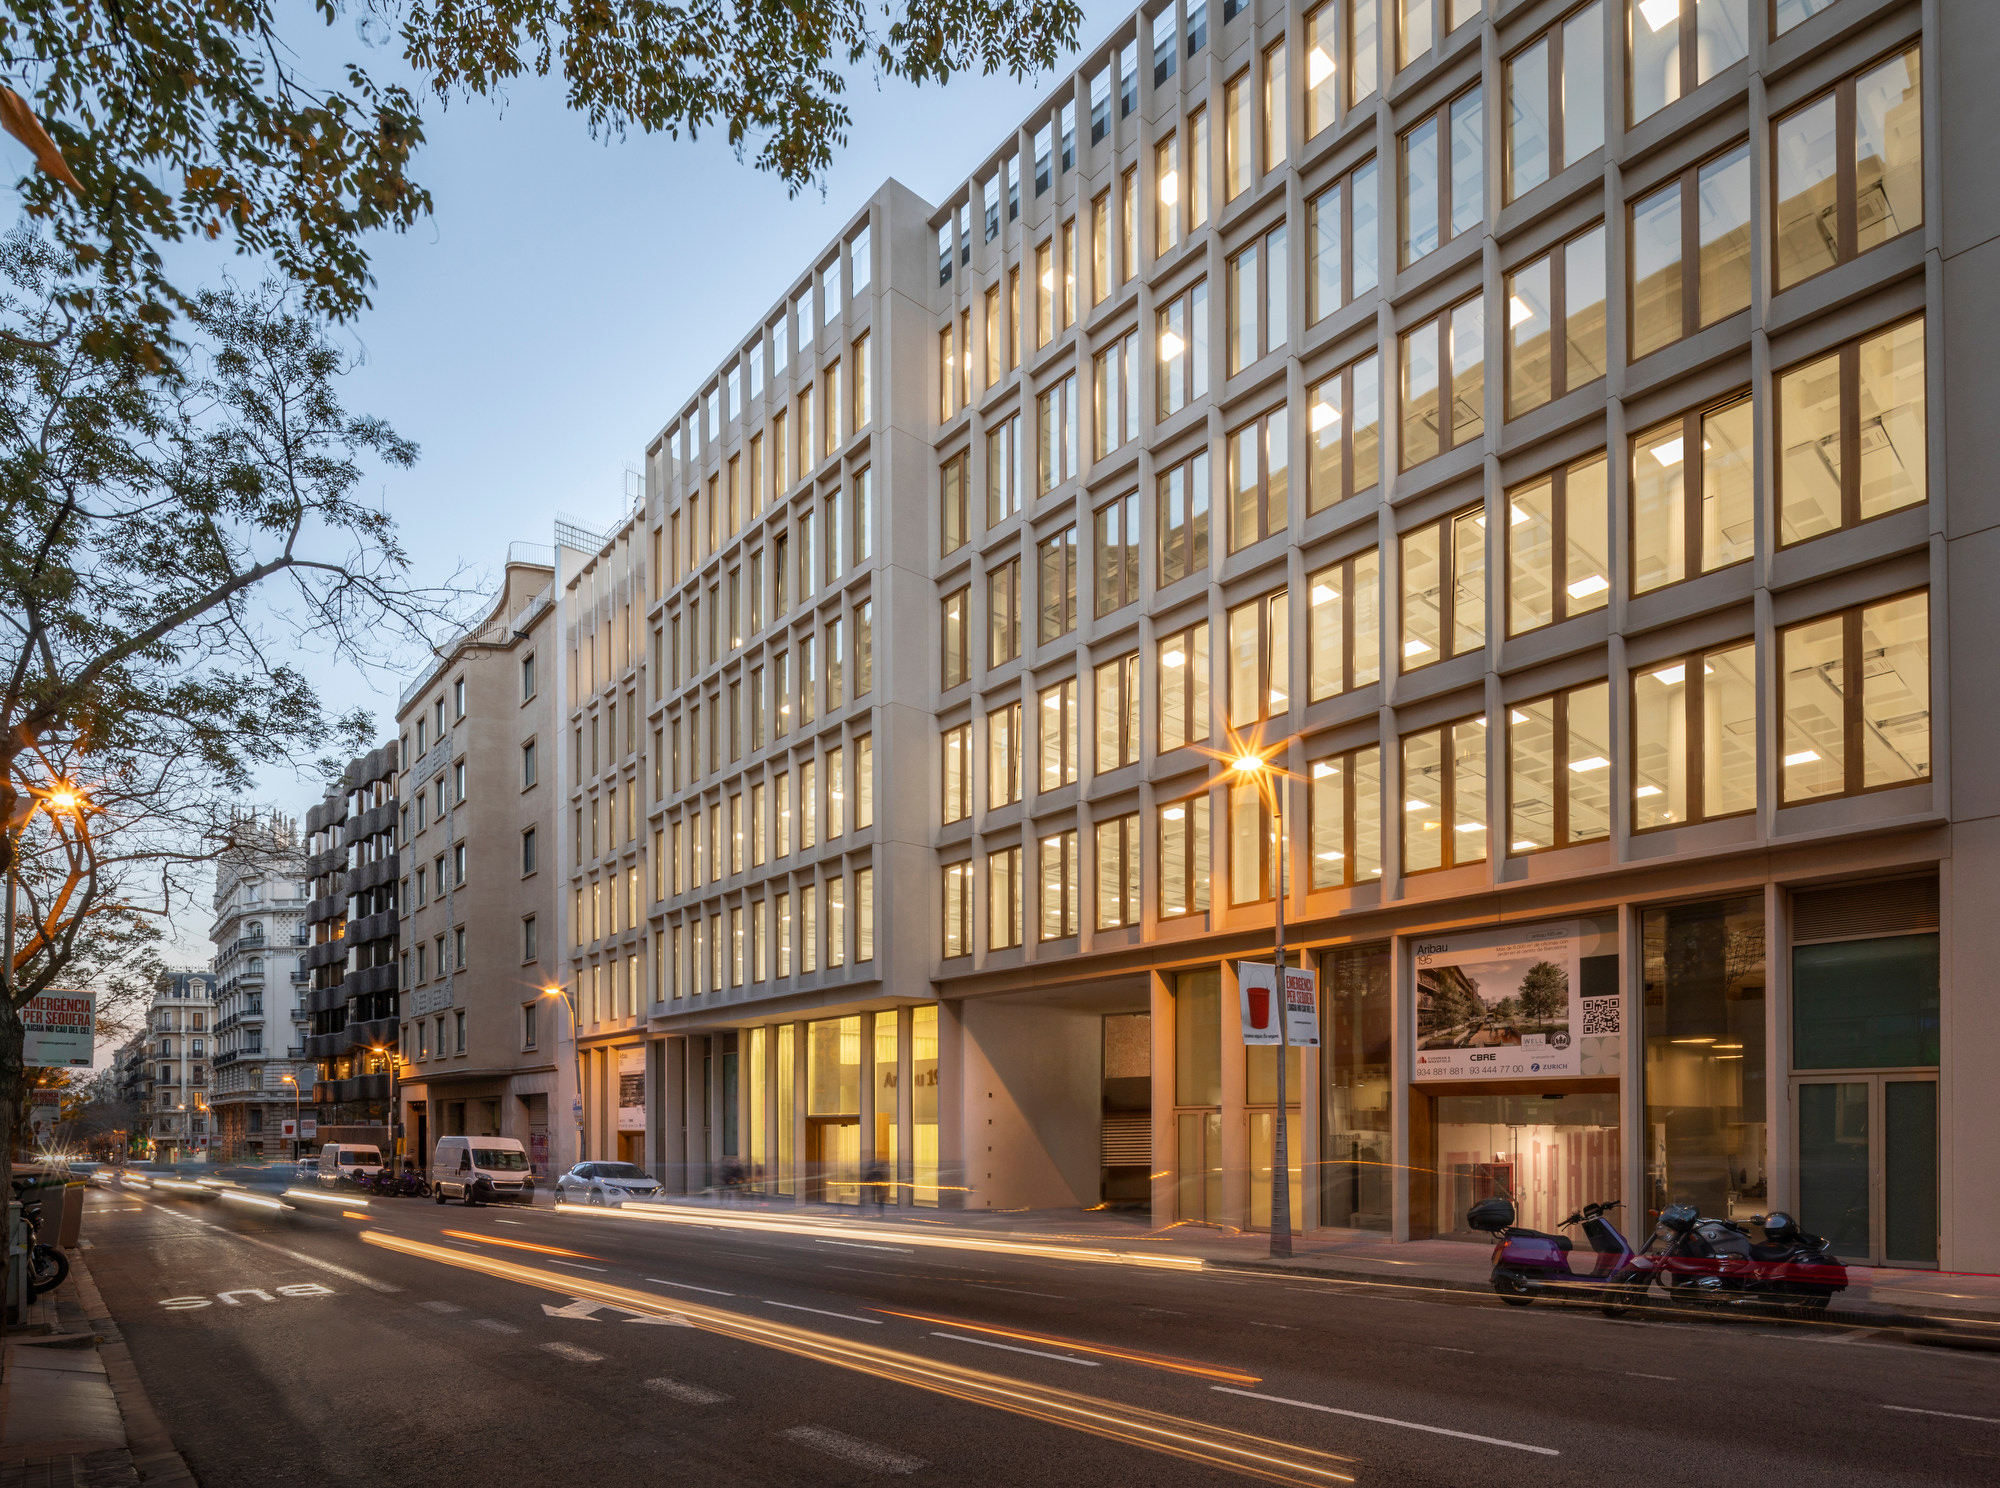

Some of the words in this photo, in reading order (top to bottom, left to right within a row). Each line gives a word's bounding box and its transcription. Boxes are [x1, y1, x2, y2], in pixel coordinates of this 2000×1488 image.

[1417, 944, 1448, 955] Aribau
[1417, 955, 1432, 965] 195
[23, 1010, 42, 1024] PER
[46, 1012, 90, 1026] SEQUERA
[56, 1026, 68, 1034] CAU
[68, 1026, 78, 1034] DEL
[1450, 1067, 1464, 1075] 881
[1470, 1066, 1480, 1074] 93
[1482, 1066, 1497, 1074] 444
[1512, 1064, 1524, 1073] 00
